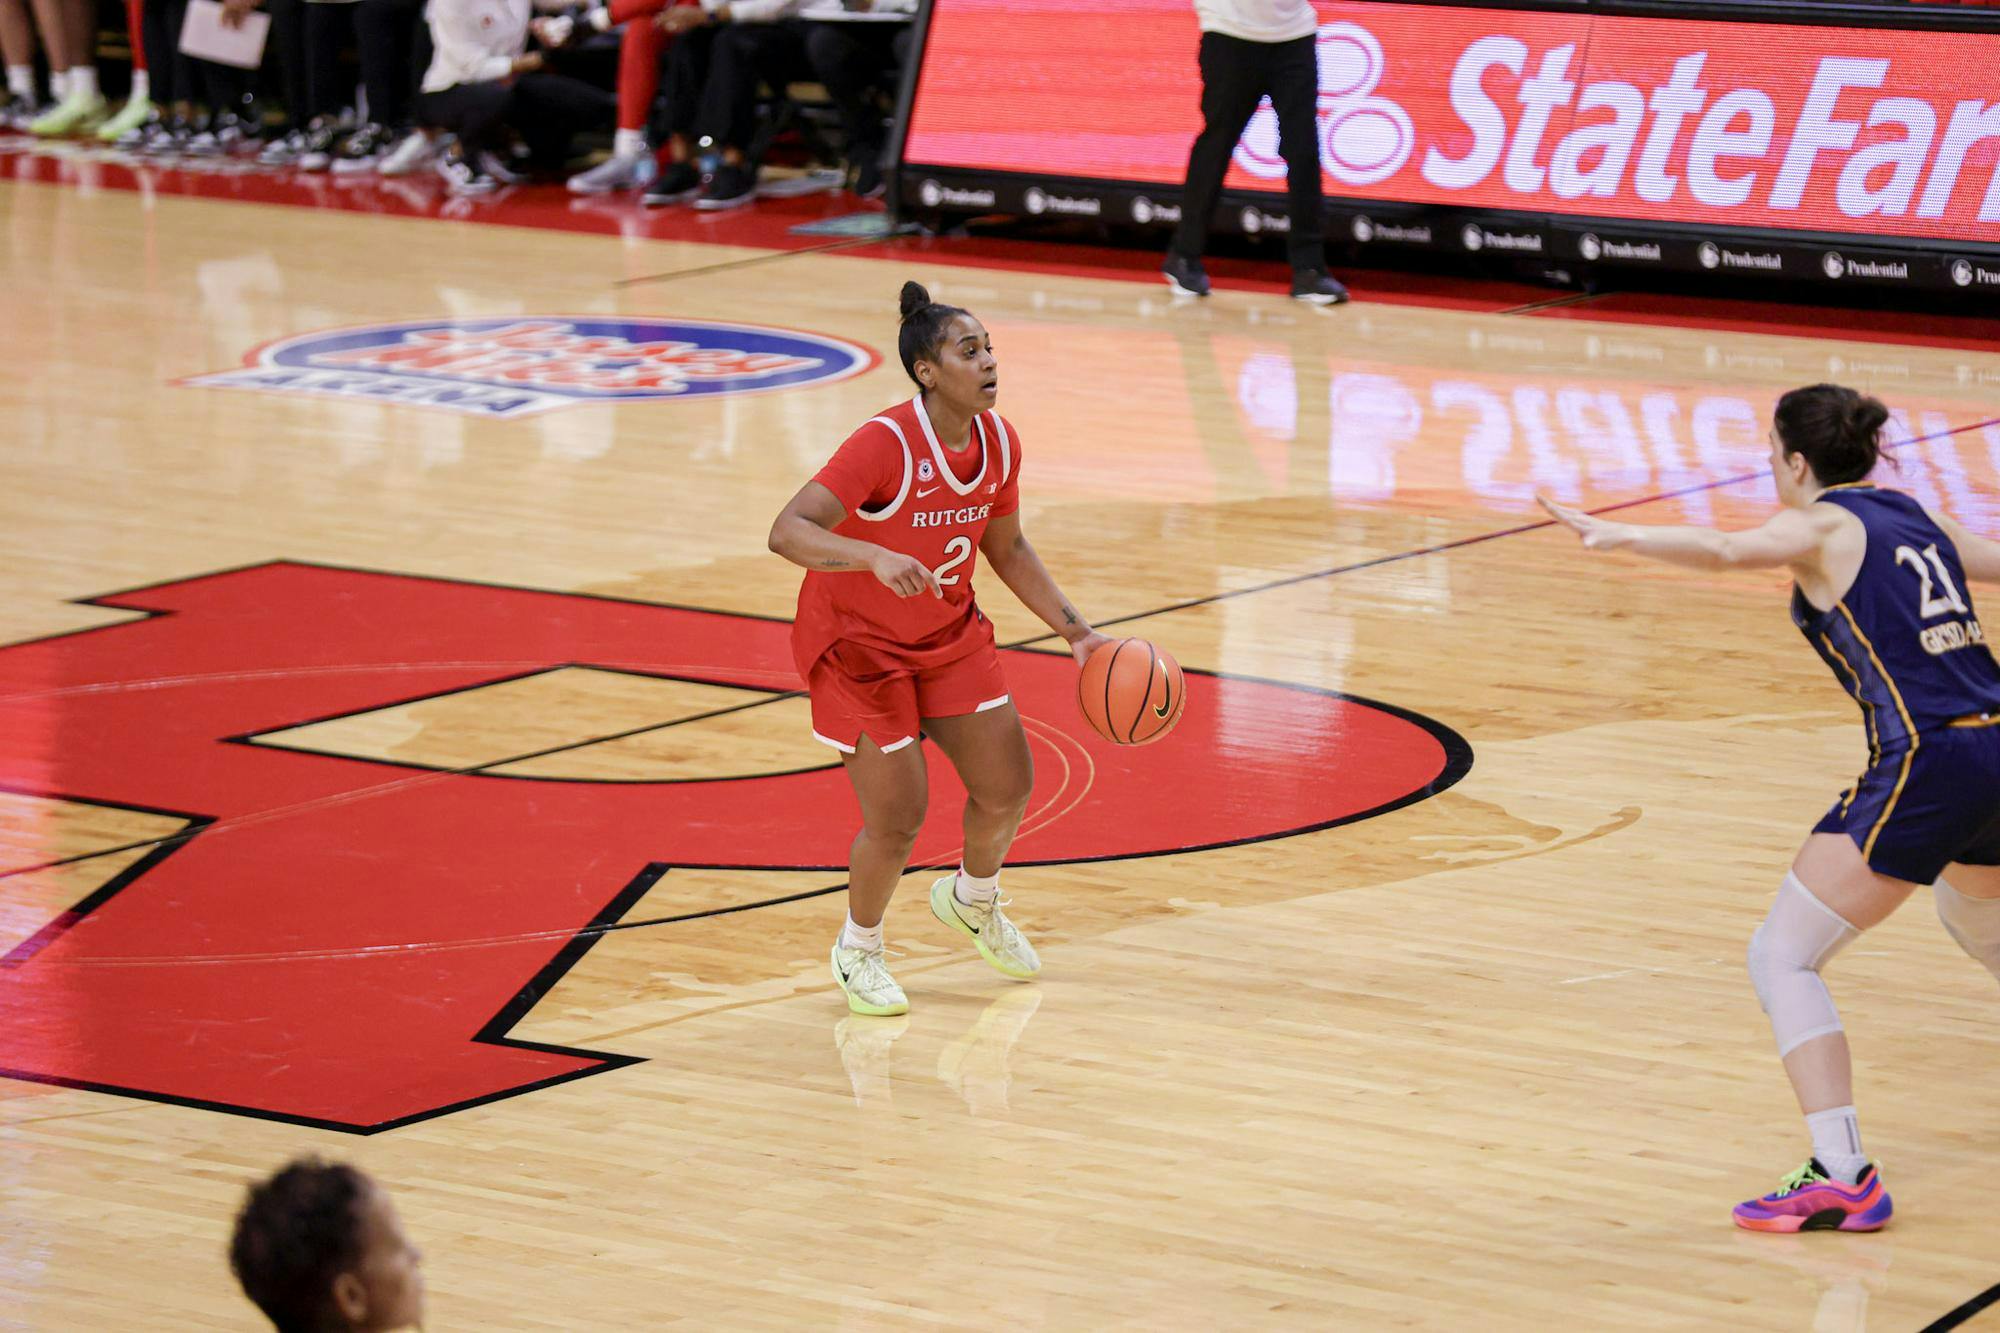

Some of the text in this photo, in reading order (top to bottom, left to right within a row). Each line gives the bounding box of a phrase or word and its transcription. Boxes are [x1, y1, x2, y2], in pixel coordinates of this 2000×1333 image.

[1768, 56, 2000, 222] Far
[1602, 240, 1660, 260] Prudential
[1722, 250, 1781, 270] Prudential
[1848, 259, 1908, 279] Prudential
[912, 503, 994, 527] RUTGER
[933, 535, 972, 585] 2
[1896, 543, 1969, 619] 21
